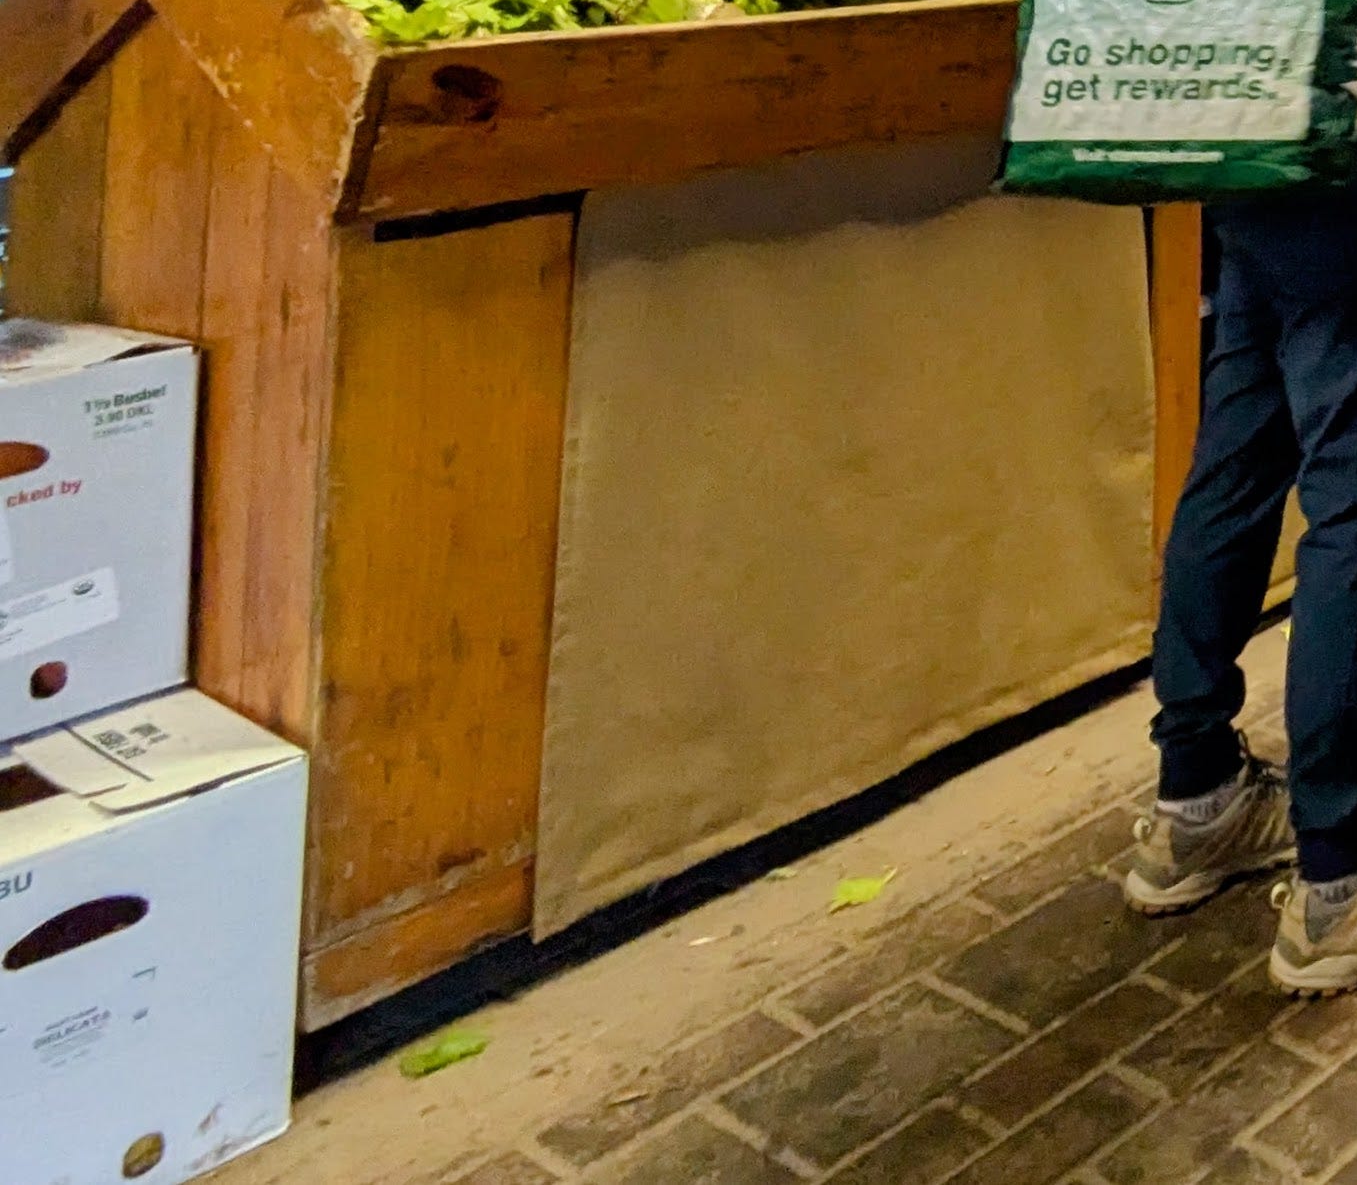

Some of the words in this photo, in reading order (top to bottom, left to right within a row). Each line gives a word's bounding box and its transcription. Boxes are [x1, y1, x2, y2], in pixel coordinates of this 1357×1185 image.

[1047, 38, 1091, 66] Go
[1041, 73, 1103, 108] get
[1113, 71, 1278, 101] rewards.
[113, 384, 168, 408] Bushel
[60, 480, 83, 495] by
